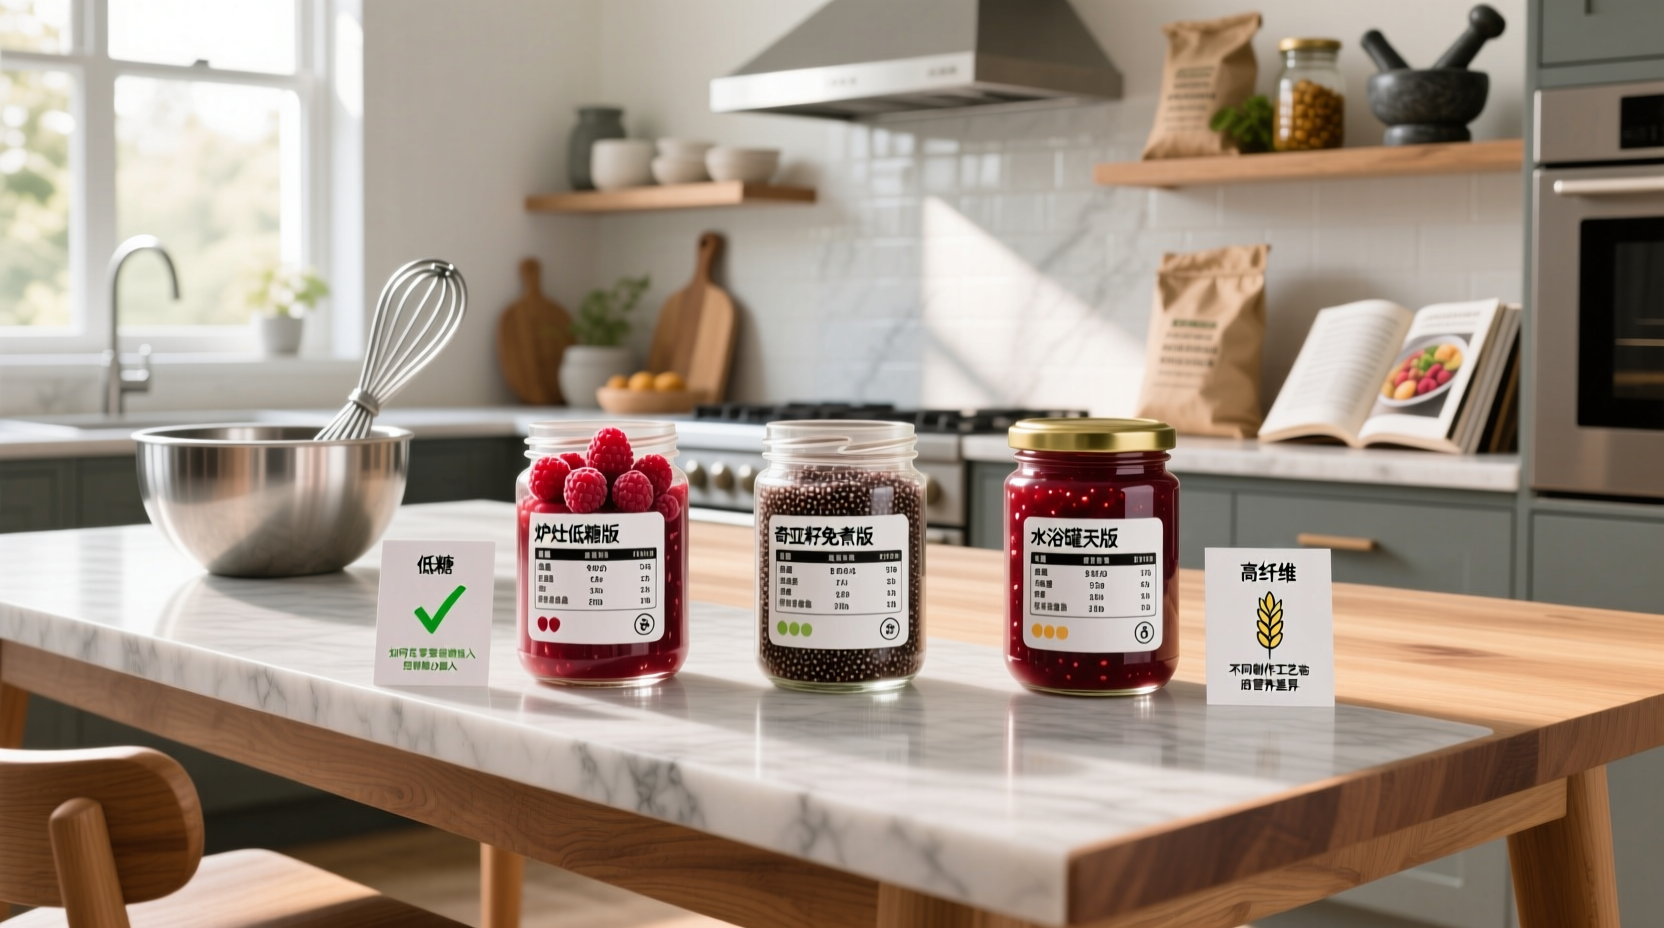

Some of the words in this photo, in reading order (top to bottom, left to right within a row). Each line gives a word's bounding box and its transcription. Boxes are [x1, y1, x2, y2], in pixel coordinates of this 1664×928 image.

[534, 522, 620, 545] 炉灶低糖版
[774, 525, 874, 547] 奇亚籽免煮版
[416, 554, 454, 575] 低糖
[1240, 560, 1297, 583] 高纤维
